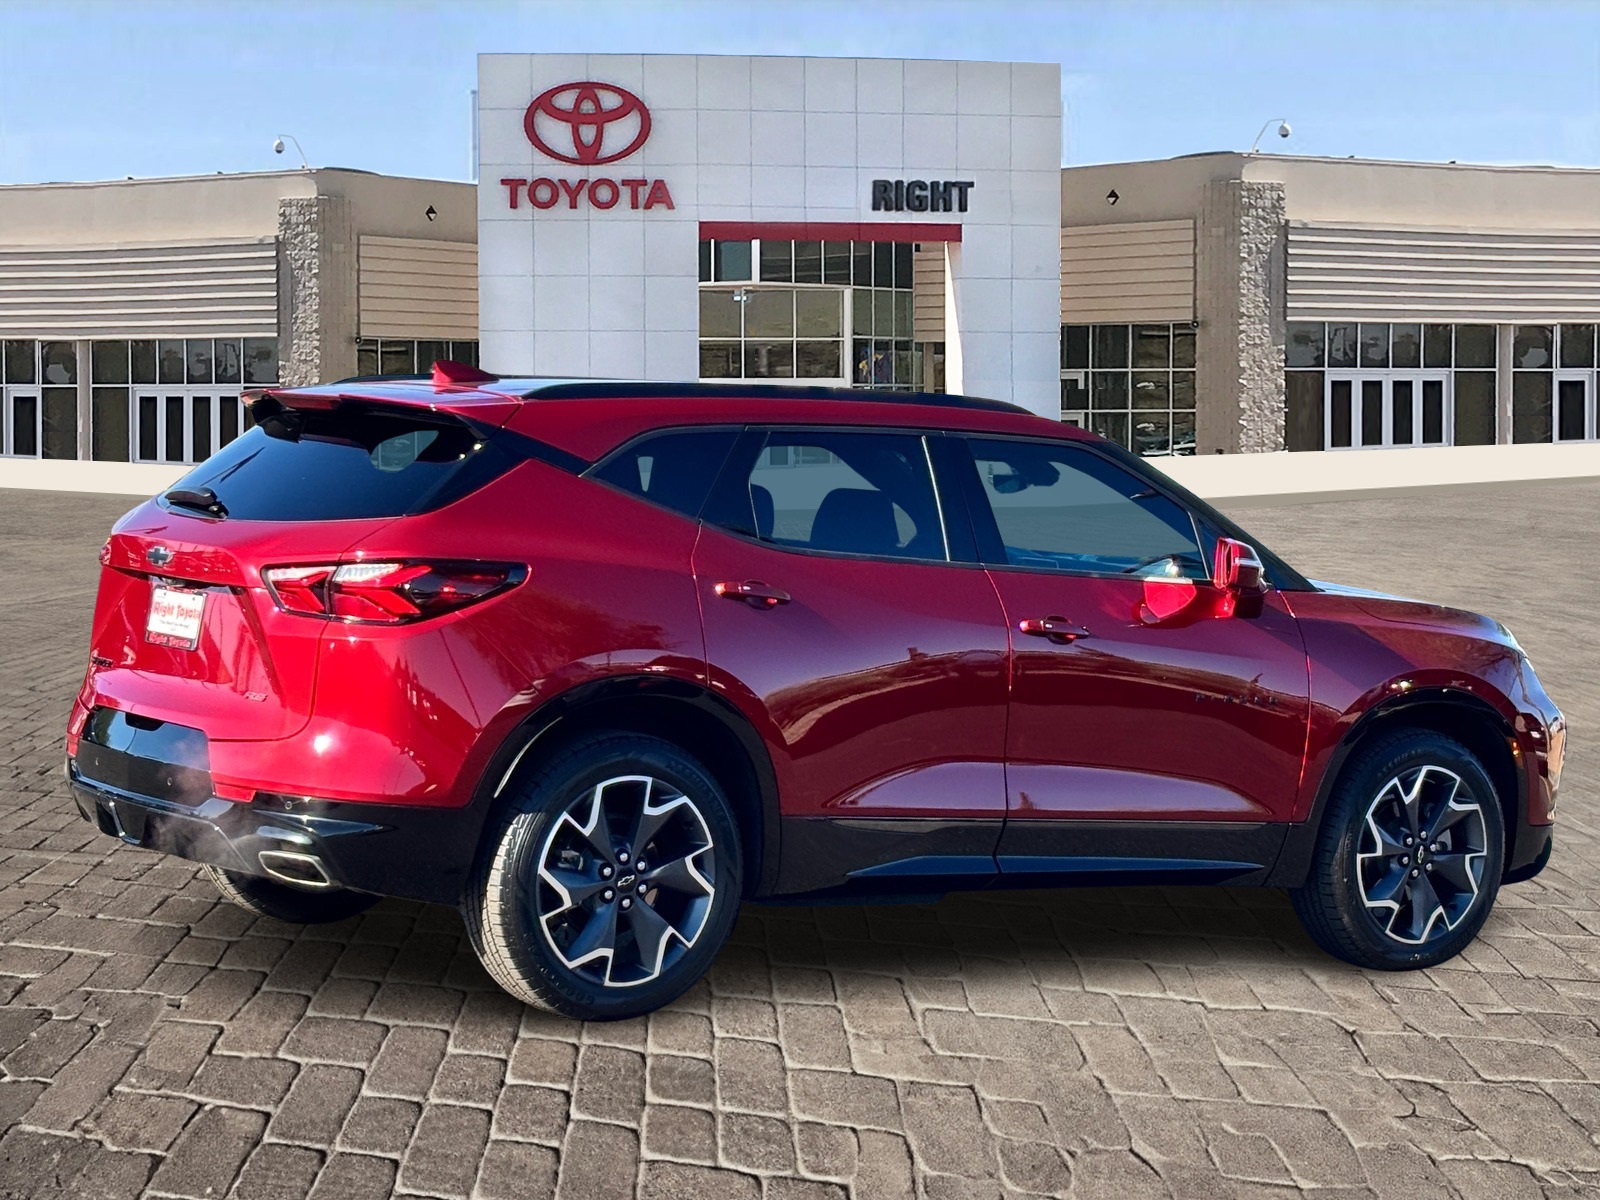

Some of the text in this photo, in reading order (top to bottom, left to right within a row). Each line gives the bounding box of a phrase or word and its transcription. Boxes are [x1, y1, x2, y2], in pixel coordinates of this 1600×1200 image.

[501, 179, 675, 210] TOYOTA
[872, 180, 975, 212] RIGHT
[153, 601, 201, 620] Right Toyota
